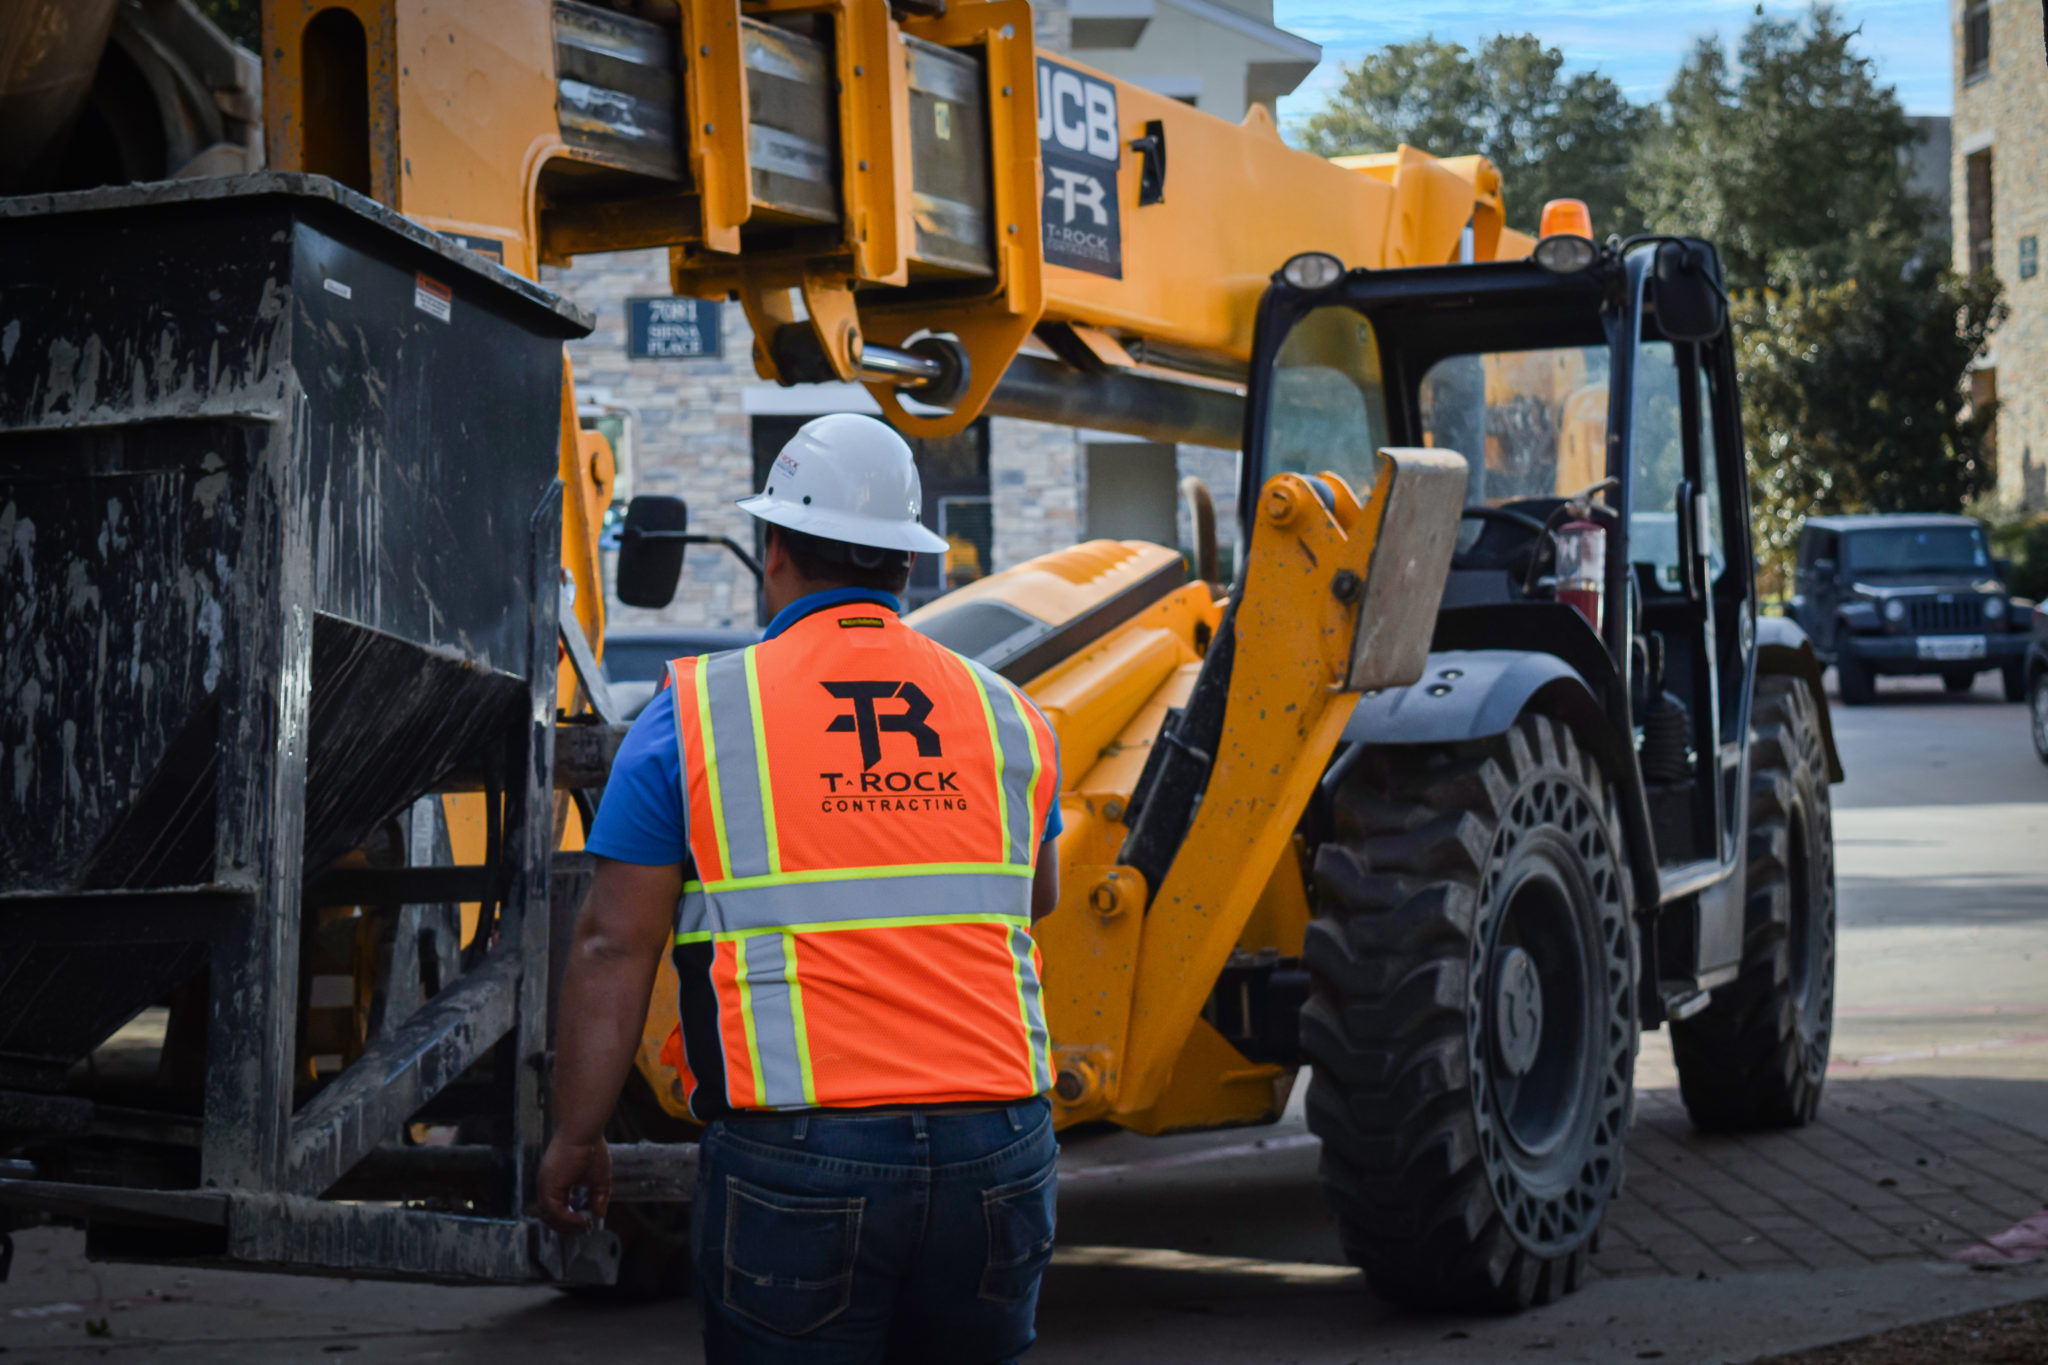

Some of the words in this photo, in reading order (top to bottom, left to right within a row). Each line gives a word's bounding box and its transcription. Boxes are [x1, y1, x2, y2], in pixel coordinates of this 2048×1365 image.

[1038, 65, 1118, 161] JCB
[648, 340, 703, 355] PLACE
[821, 799, 967, 813] CONTRACTING
